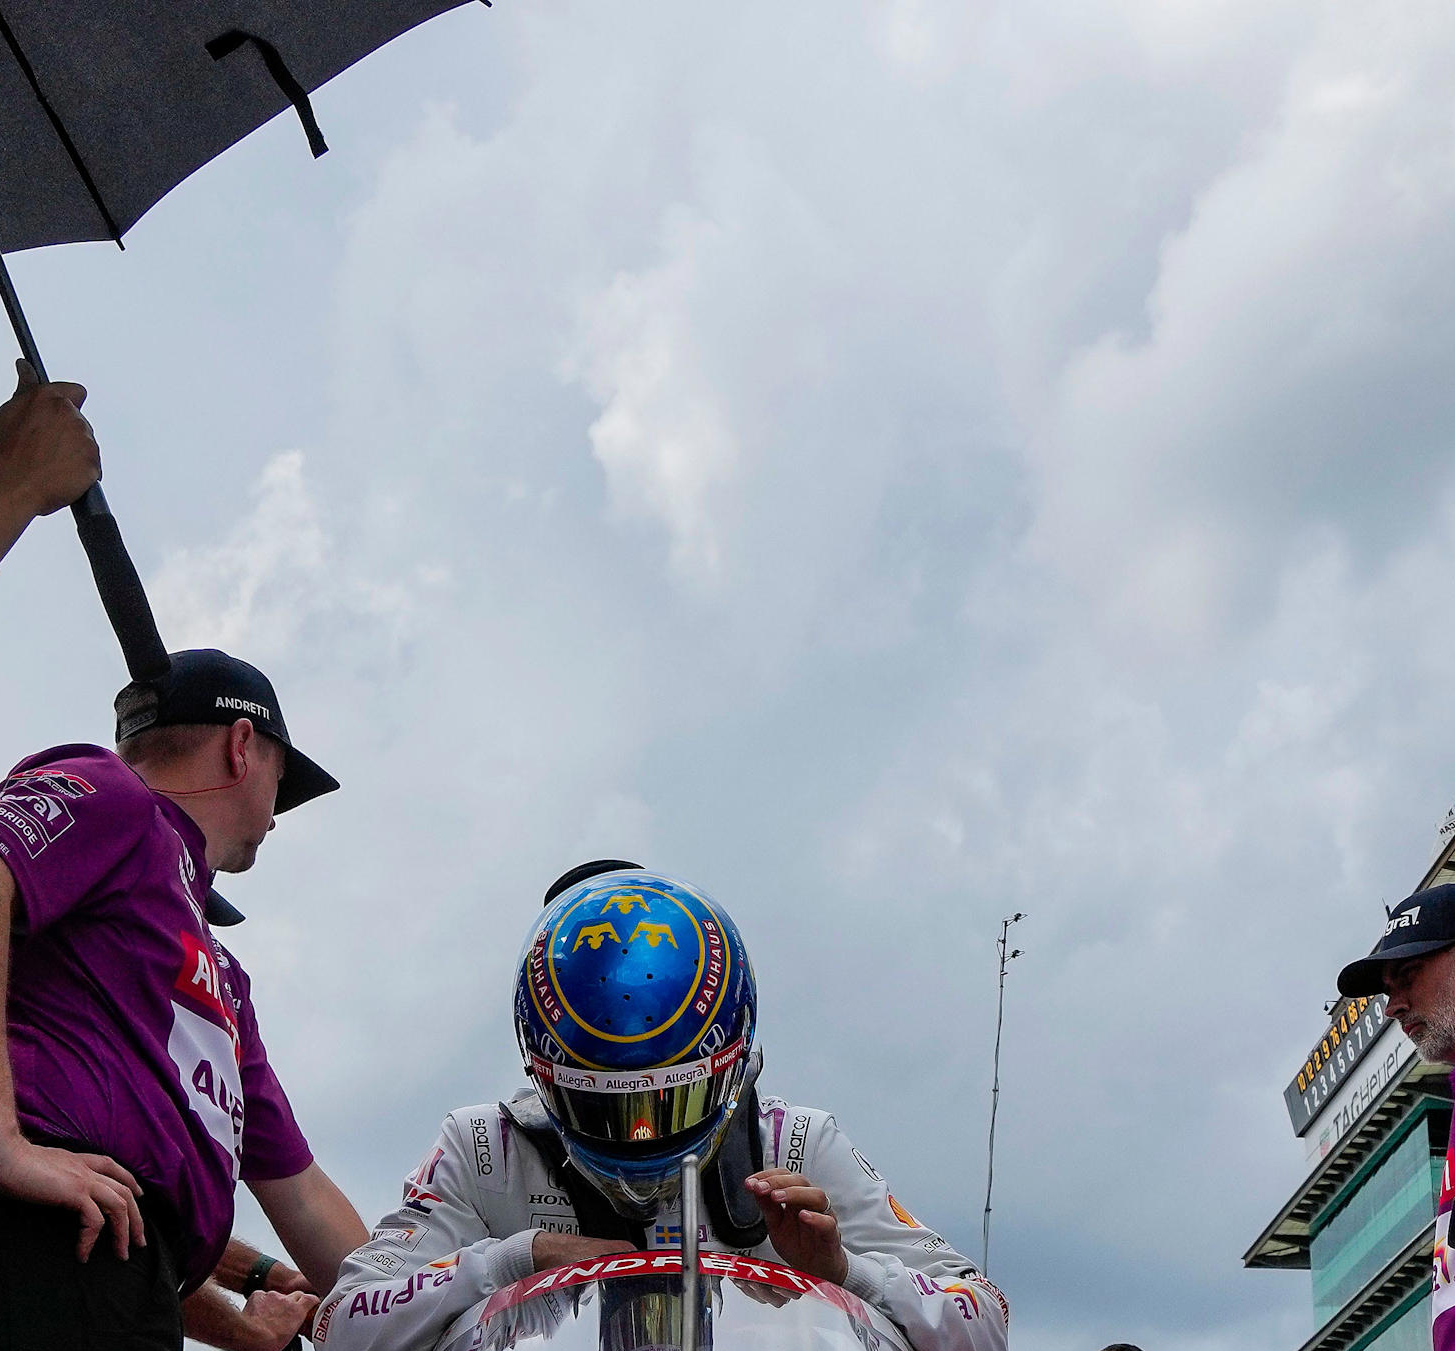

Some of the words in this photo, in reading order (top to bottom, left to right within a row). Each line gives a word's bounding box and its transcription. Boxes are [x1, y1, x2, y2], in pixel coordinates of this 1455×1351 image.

[215, 697, 270, 720] ANDRETTI
[531, 930, 562, 1023] BAUHAUS
[696, 920, 722, 1016] BAUHAUS
[1311, 1085, 1320, 1108] 2
[1320, 1074, 1328, 1096] 3
[1329, 1063, 1337, 1084] 4
[1336, 1051, 1346, 1074] 5
[1346, 1039, 1355, 1062] 6
[1355, 1026, 1363, 1050] 7
[1365, 1014, 1374, 1037] 8
[1374, 1001, 1384, 1025] 9
[1322, 1040, 1330, 1060] 9
[1340, 1015, 1348, 1034] 4
[557, 1072, 596, 1089] Allegra
[605, 1074, 656, 1091] Allegra
[664, 1063, 708, 1085] Allegra
[475, 1117, 493, 1176] sparco
[785, 1114, 808, 1174] sparco
[529, 1193, 573, 1206] HON
[524, 1253, 826, 1299] ANDRETTI
